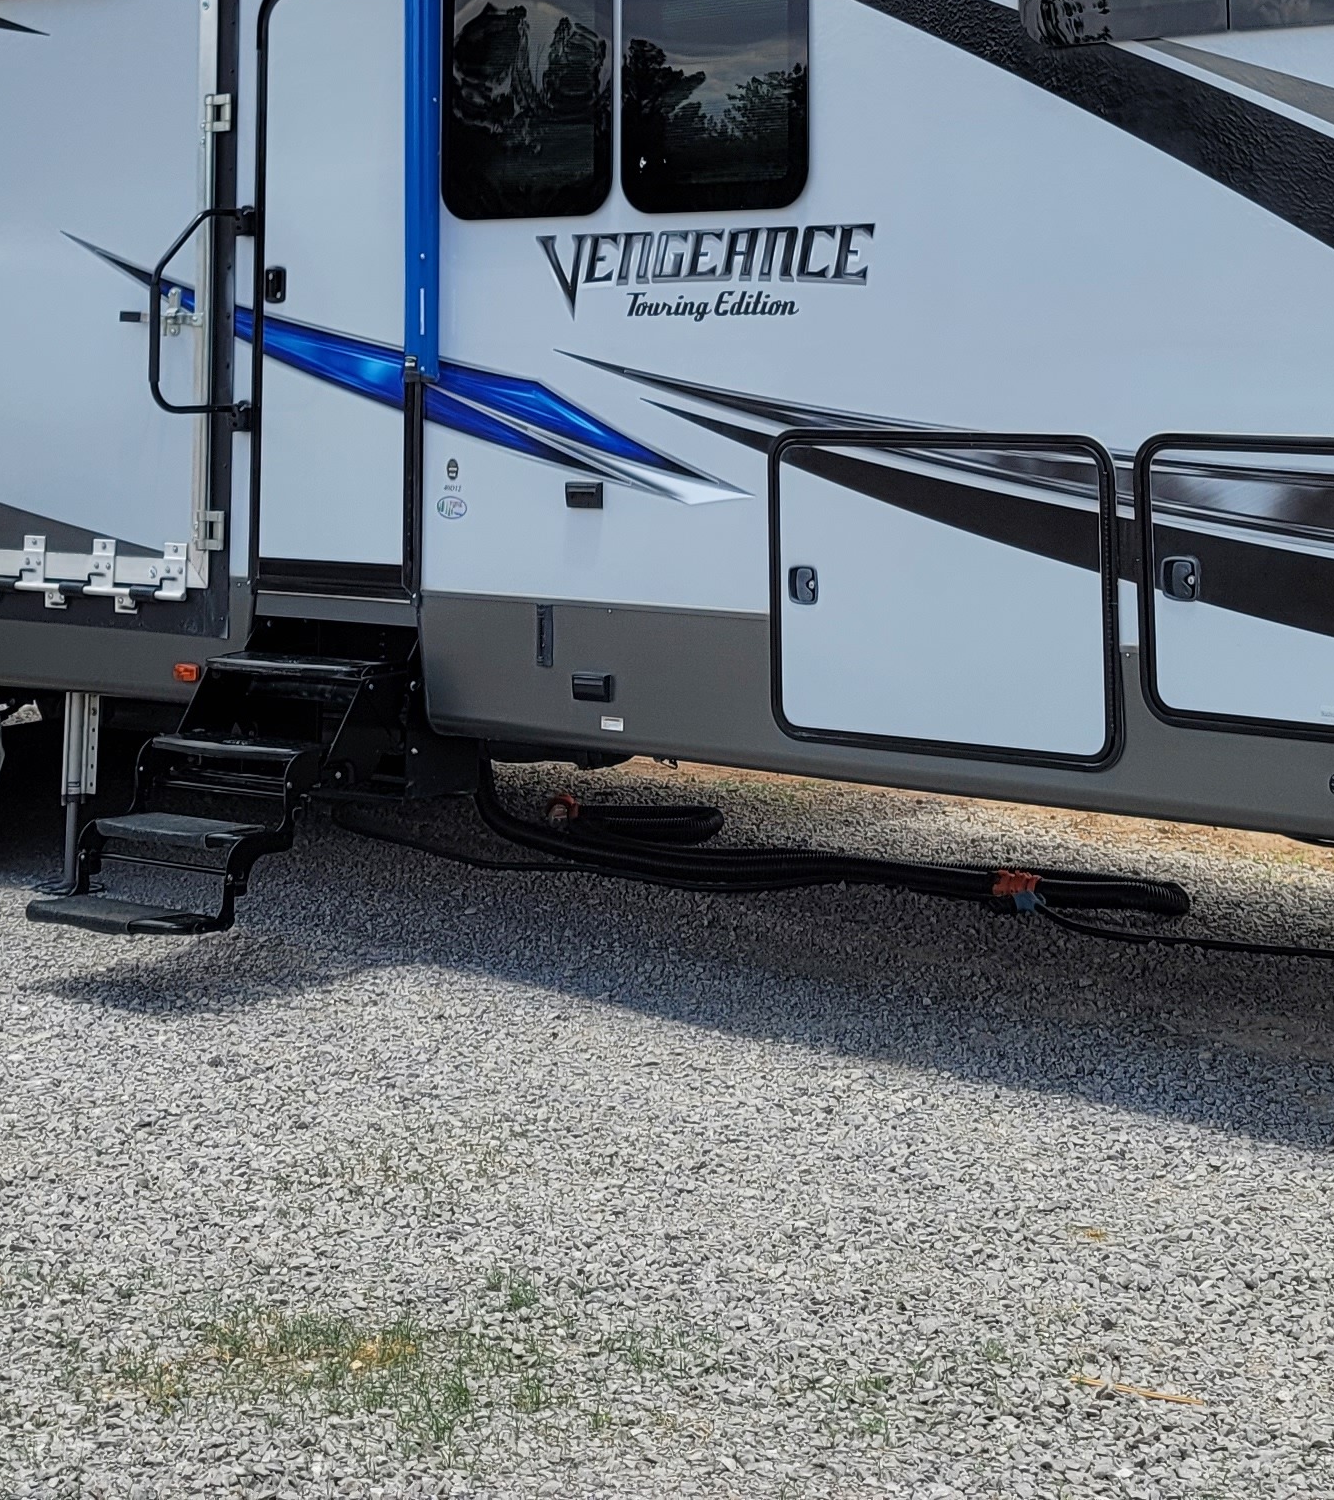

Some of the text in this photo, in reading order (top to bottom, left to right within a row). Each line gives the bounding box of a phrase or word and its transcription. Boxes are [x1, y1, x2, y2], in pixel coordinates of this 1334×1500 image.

[535, 222, 876, 322] VENGEANCE
[626, 290, 800, 322] Touring Edition
